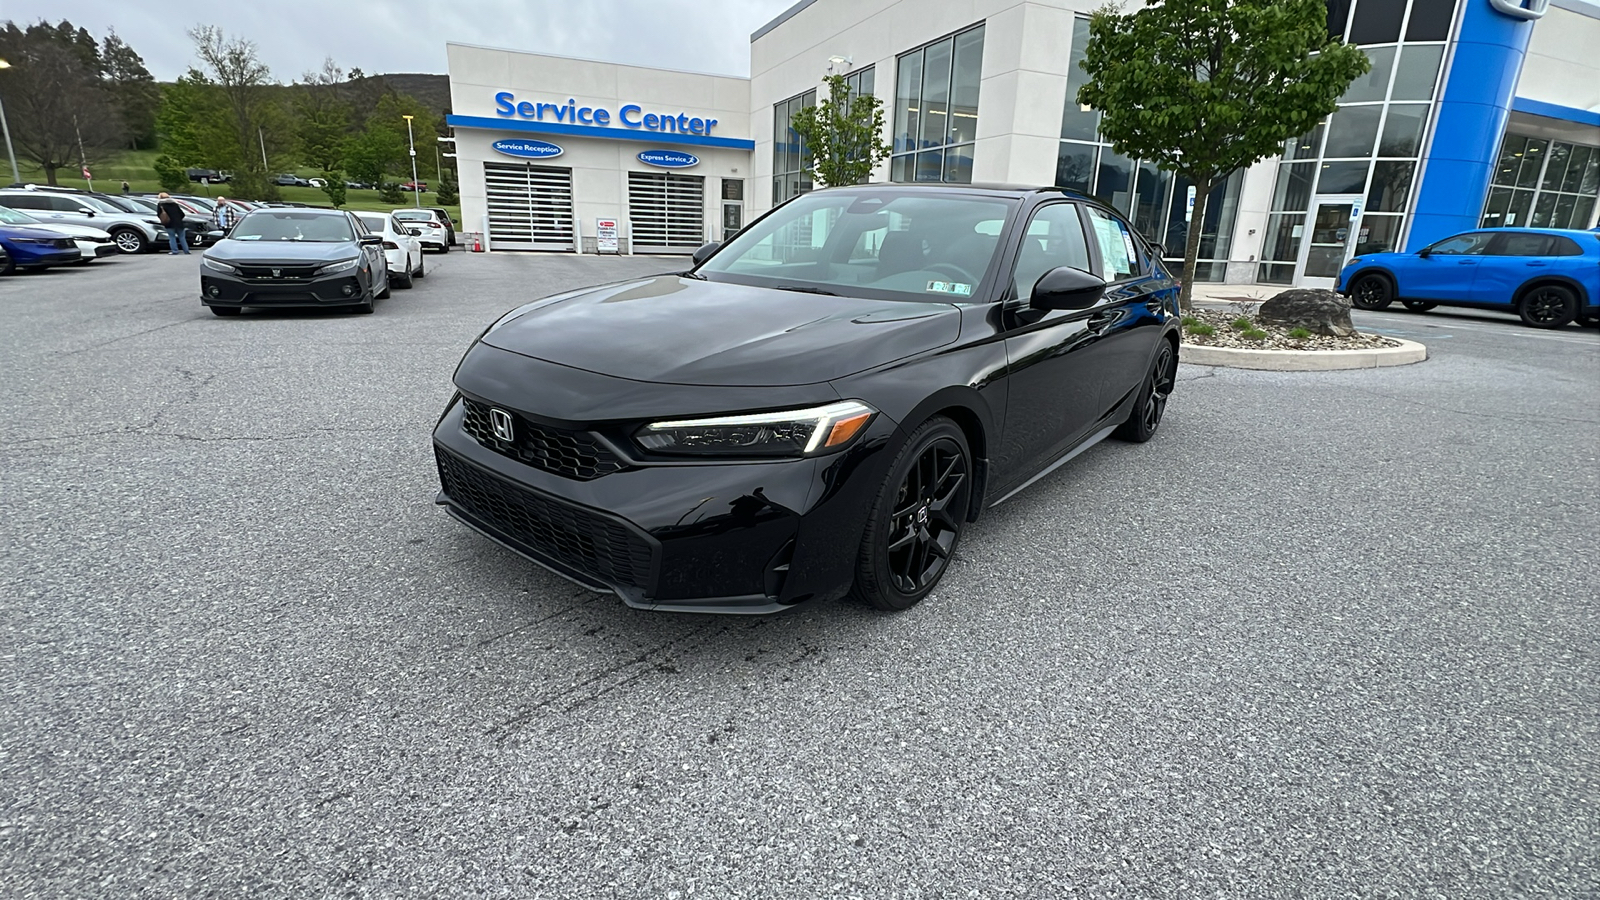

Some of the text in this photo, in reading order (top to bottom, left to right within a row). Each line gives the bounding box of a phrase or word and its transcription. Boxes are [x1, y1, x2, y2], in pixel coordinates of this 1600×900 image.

[495, 91, 718, 135] Service Center
[496, 142, 559, 154] Service Reception
[640, 153, 687, 163] Express Service
